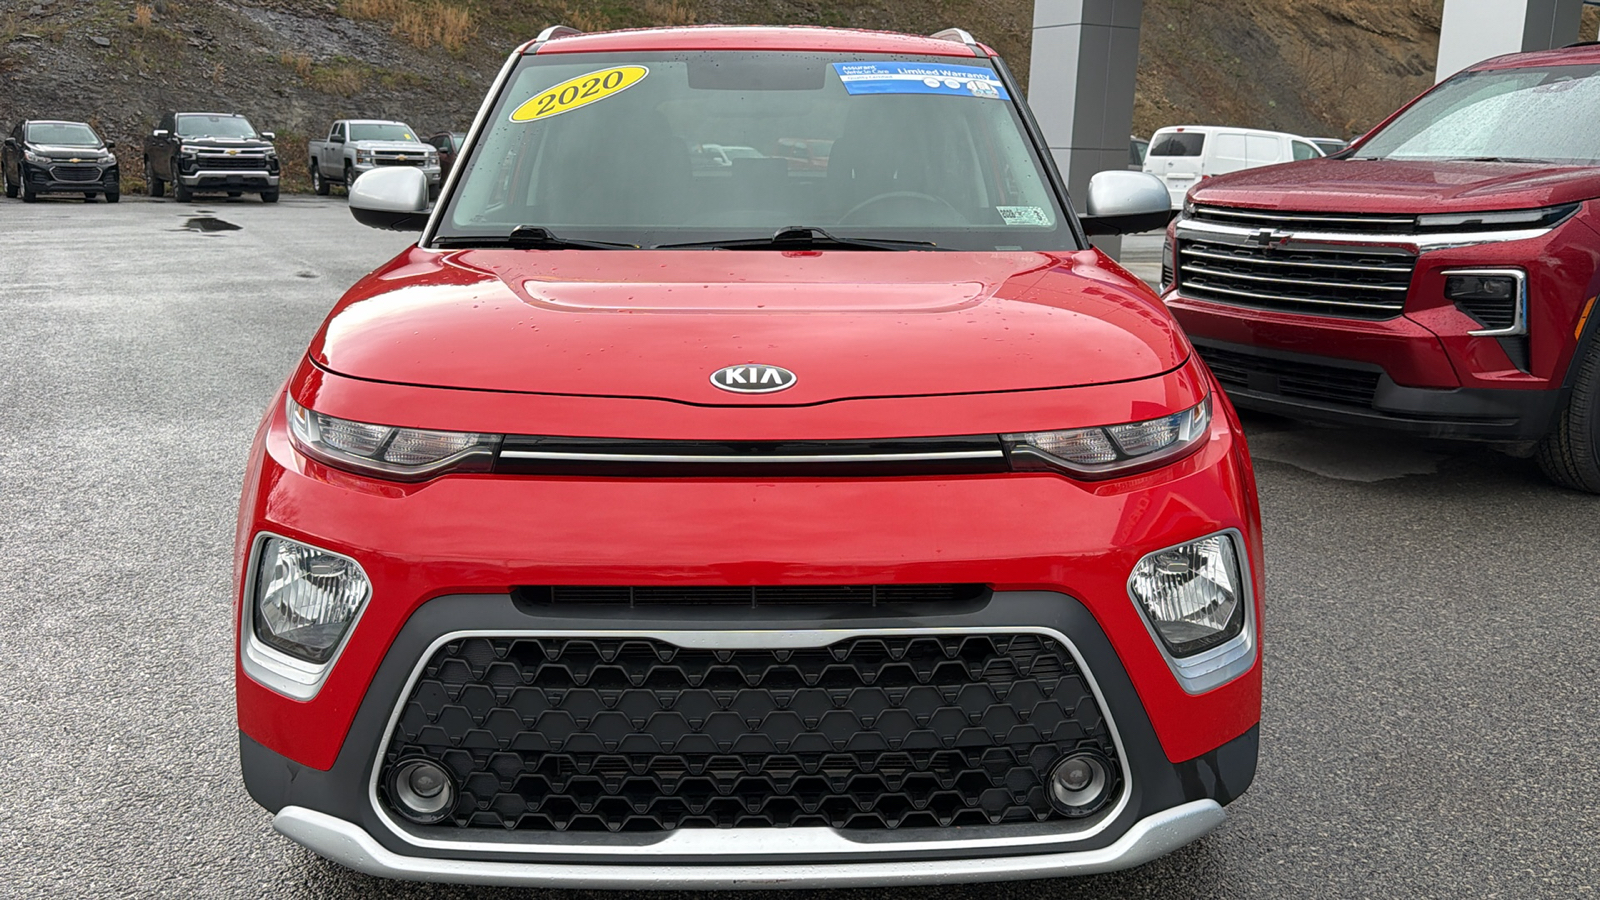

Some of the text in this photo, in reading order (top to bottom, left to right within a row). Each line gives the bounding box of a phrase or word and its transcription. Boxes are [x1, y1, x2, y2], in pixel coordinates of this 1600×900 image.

[897, 68, 990, 80] Limited Warranty
[535, 71, 624, 116] 2020
[725, 367, 783, 385] KIA
